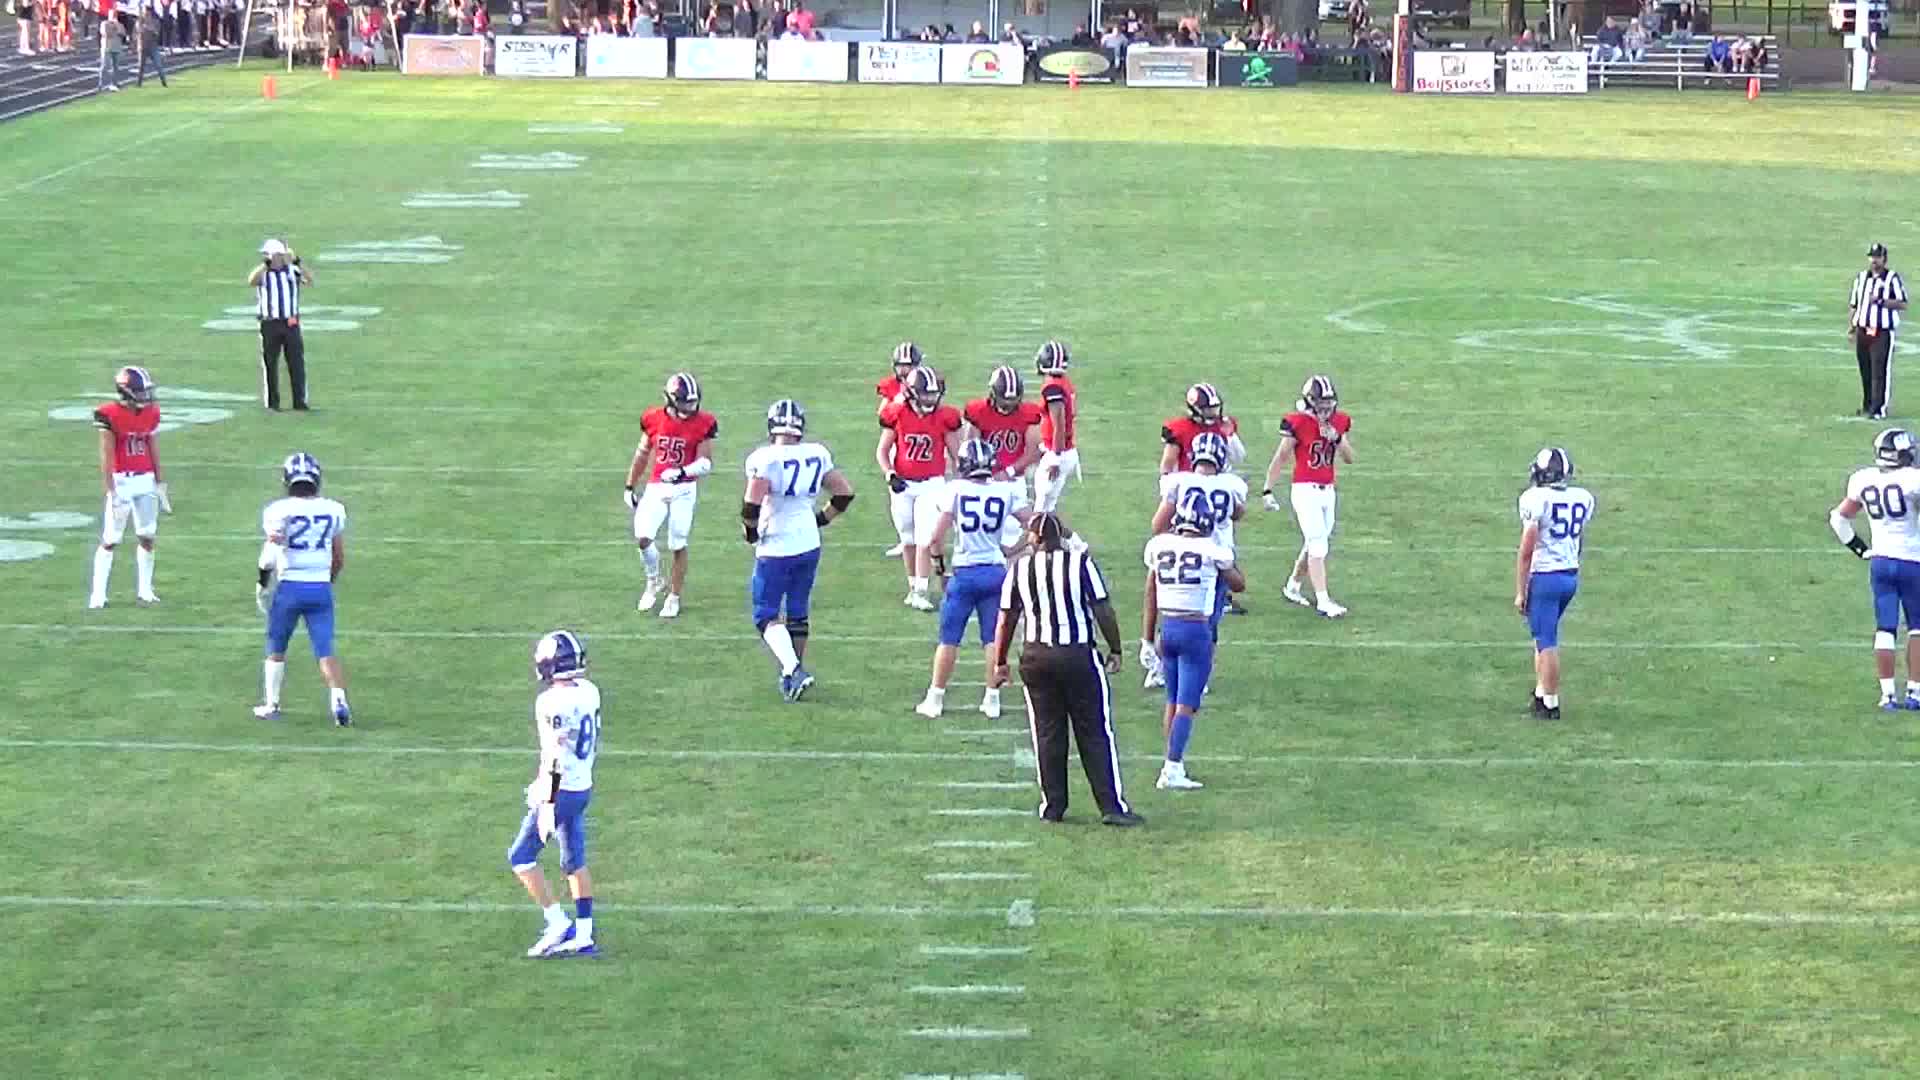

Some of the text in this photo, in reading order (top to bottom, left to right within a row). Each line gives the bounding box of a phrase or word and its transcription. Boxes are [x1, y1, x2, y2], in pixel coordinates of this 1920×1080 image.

[656, 435, 687, 466] 55
[904, 433, 933, 461] 72
[988, 428, 1020, 453] 60
[783, 456, 822, 496] 77
[960, 495, 1006, 533] 59
[1860, 483, 1908, 520] 80
[287, 513, 333, 550] 27
[1549, 502, 1586, 539] 58
[1157, 551, 1202, 585] 22
